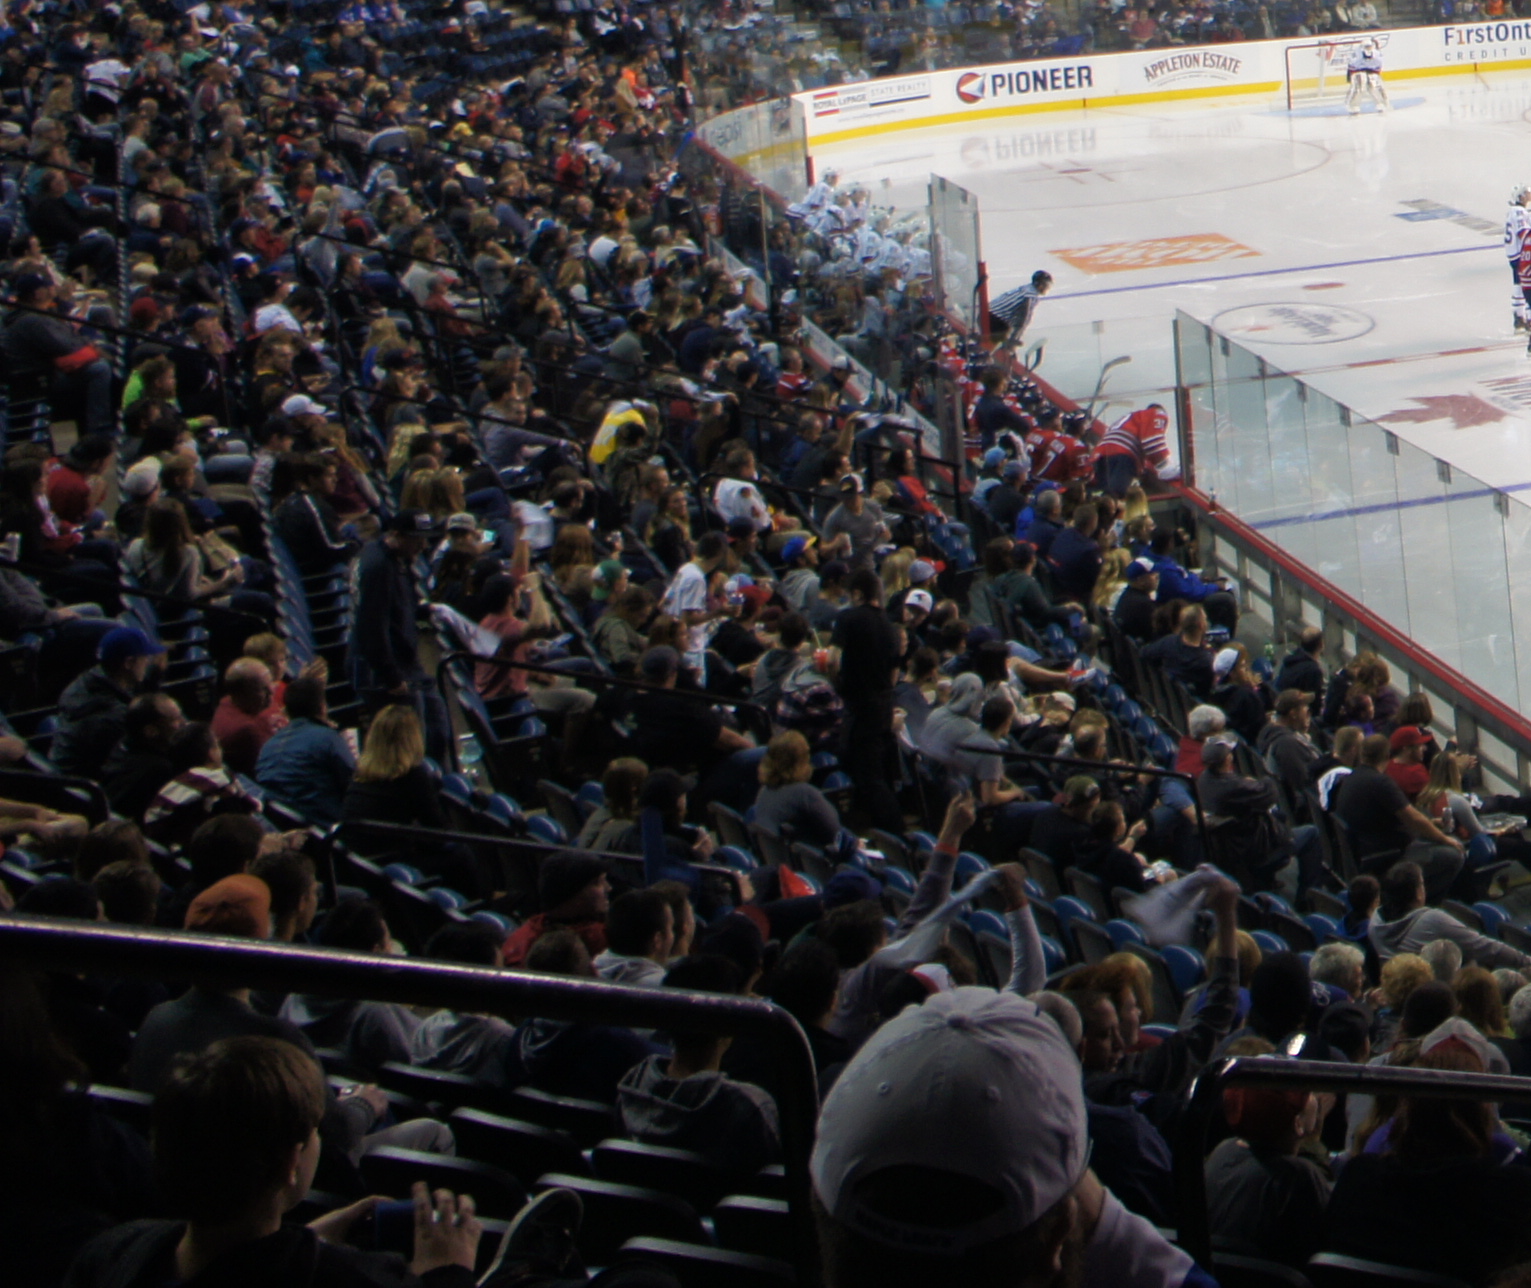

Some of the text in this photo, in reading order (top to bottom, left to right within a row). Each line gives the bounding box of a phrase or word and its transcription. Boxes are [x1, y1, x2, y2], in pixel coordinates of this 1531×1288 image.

[1143, 56, 1200, 83] APPLETON
[1203, 51, 1242, 75] ESTATE
[1445, 47, 1508, 63] CREDIT
[992, 65, 1094, 98] PIONEER
